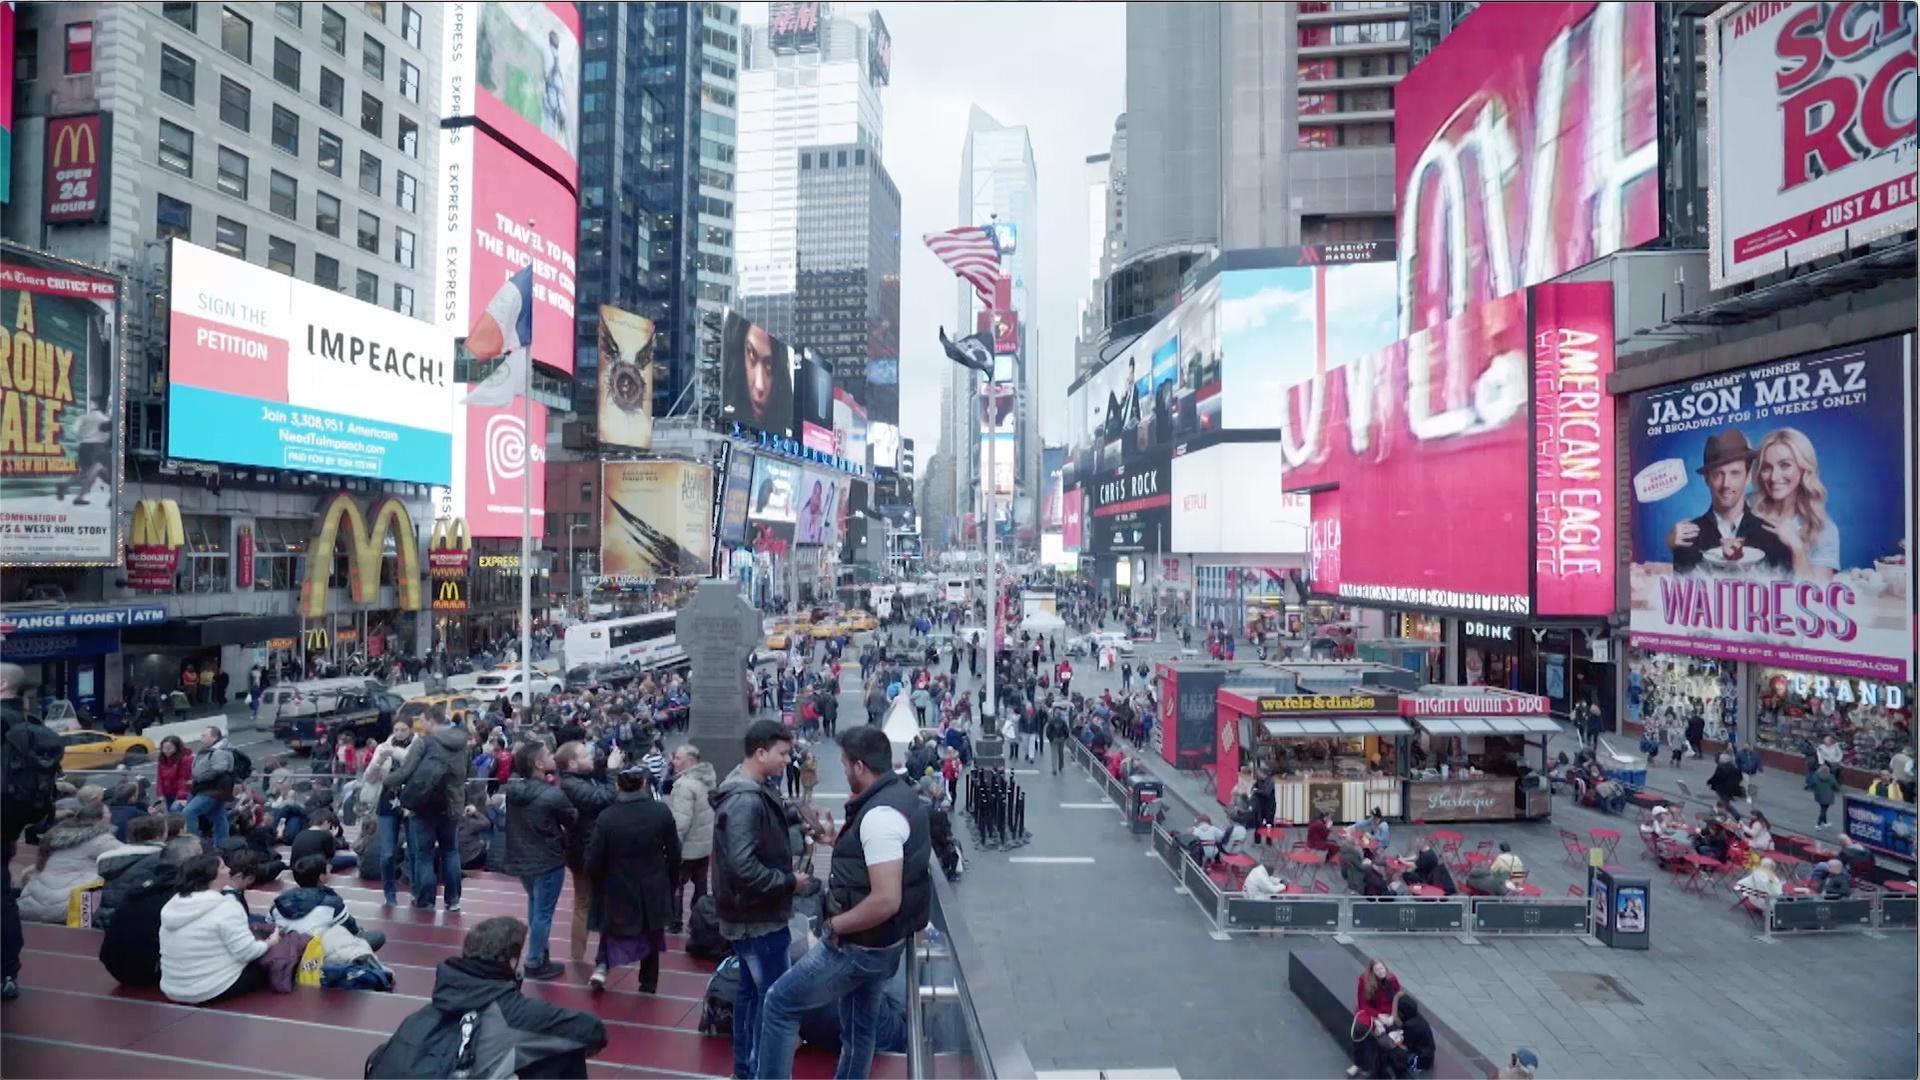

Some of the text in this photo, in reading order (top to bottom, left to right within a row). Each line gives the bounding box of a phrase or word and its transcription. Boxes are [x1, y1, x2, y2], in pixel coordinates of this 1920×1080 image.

[56, 168, 92, 181] OPEN
[59, 181, 87, 200] 24
[448, 163, 459, 232] EXPRESS
[50, 200, 96, 214] HOURS
[1821, 194, 1865, 228] JUST
[1870, 190, 1882, 210] 4
[476, 228, 504, 258] THE
[495, 213, 544, 252] TRAVEL
[546, 240, 561, 261] TO
[1325, 242, 1377, 252] MARRIOTT
[1325, 252, 1371, 261] MARQUIS
[92, 283, 115, 294] PICK
[445, 246, 457, 321] EXPRESS
[16, 290, 34, 333] A
[198, 293, 268, 327] SIGN THE
[197, 327, 268, 361] PETITION
[307, 324, 444, 387] IMPEACH!
[1750, 362, 1801, 380] WINNER
[1647, 361, 1867, 426] JASON MRAZ
[262, 406, 287, 423] Join
[290, 412, 342, 433] 3,308,951
[1647, 393, 1867, 437] ON BROADWAY FOR 10 WEEKS ONLY!
[1558, 328, 1601, 576] AMERICAN EAGLE
[1132, 470, 1158, 497] ROCK
[24, 524, 51, 534] WEST
[78, 526, 107, 536] STORY
[479, 555, 518, 567] EXPRESS
[70, 612, 125, 625] MONEY
[134, 610, 164, 621] ATM
[1658, 576, 1858, 642] WAITRESS
[1465, 621, 1512, 641] DRINK
[1415, 697, 1543, 713] MIGHTY QUINN'S BBQ
[1795, 673, 1904, 709] GRAND
